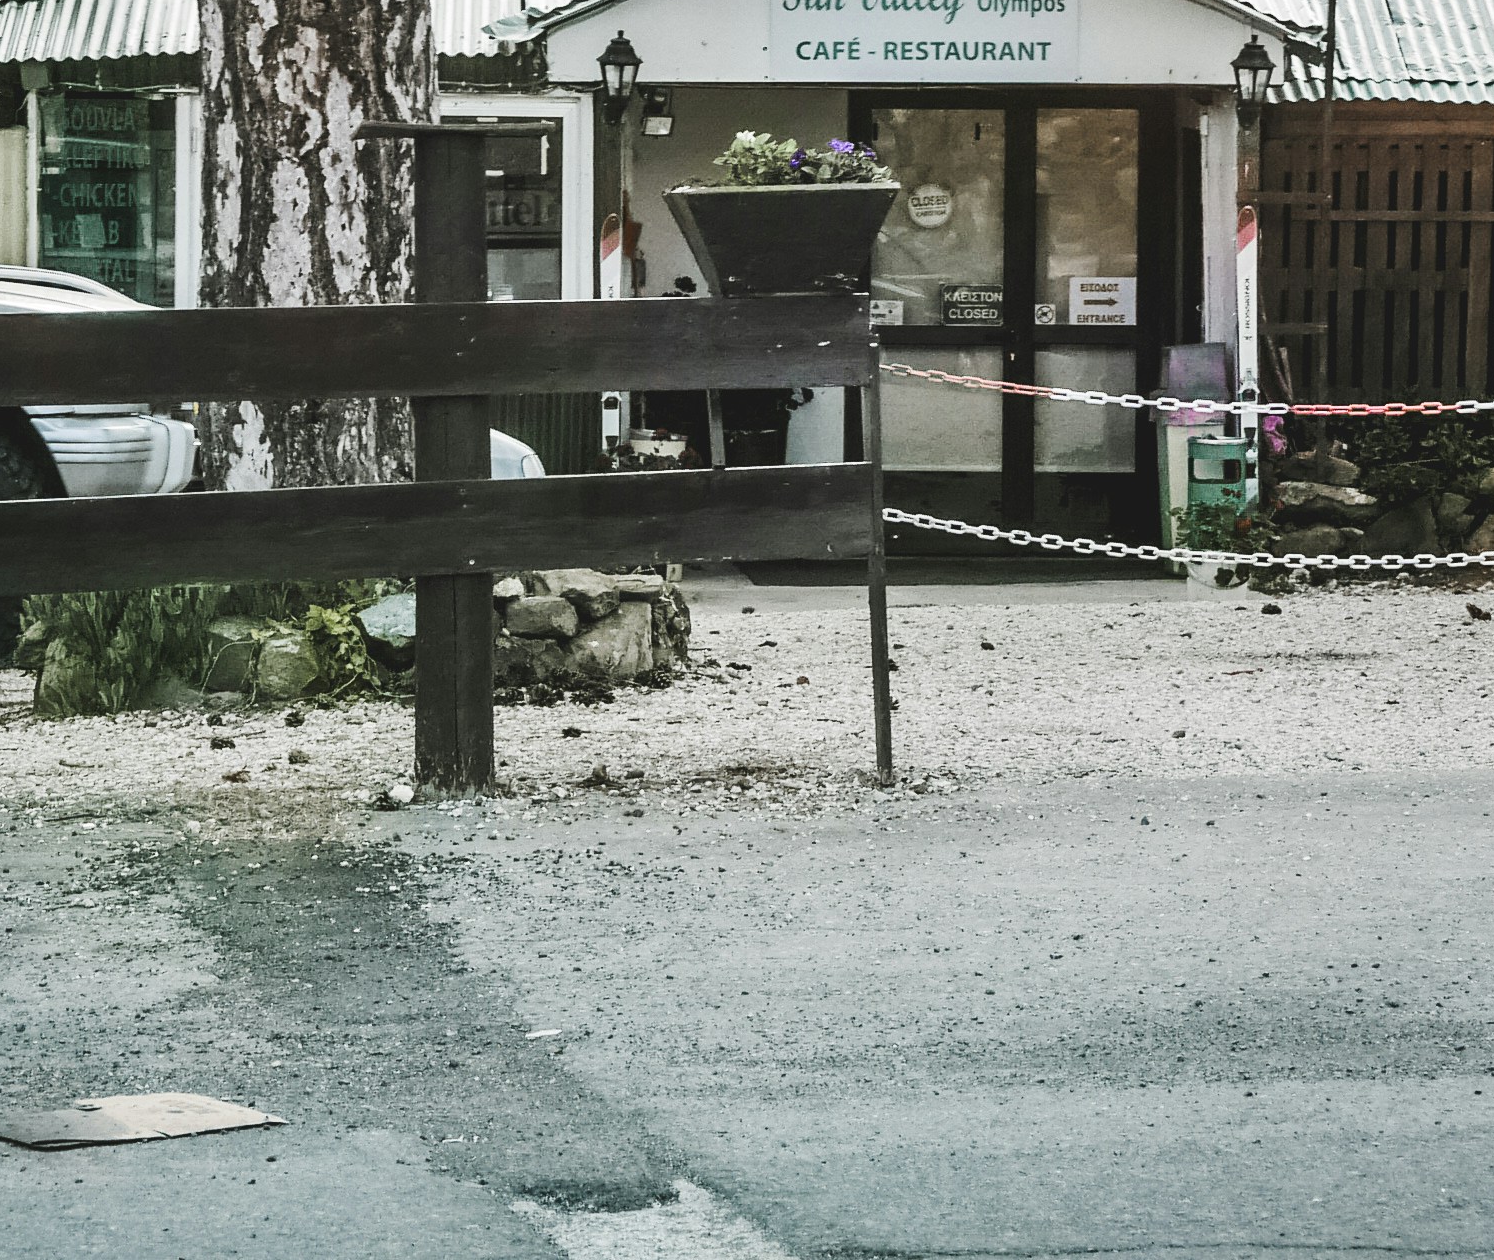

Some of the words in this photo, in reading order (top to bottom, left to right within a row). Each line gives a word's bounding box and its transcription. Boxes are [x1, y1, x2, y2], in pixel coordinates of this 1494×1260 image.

[796, 36, 861, 62] CAFÉ
[882, 41, 1053, 62] RESTAURANT
[944, 291, 1003, 302] ΚΛΕΙΣΤΟΝ
[948, 308, 998, 319] CLOSED
[1077, 314, 1126, 324] ENTRANCE
